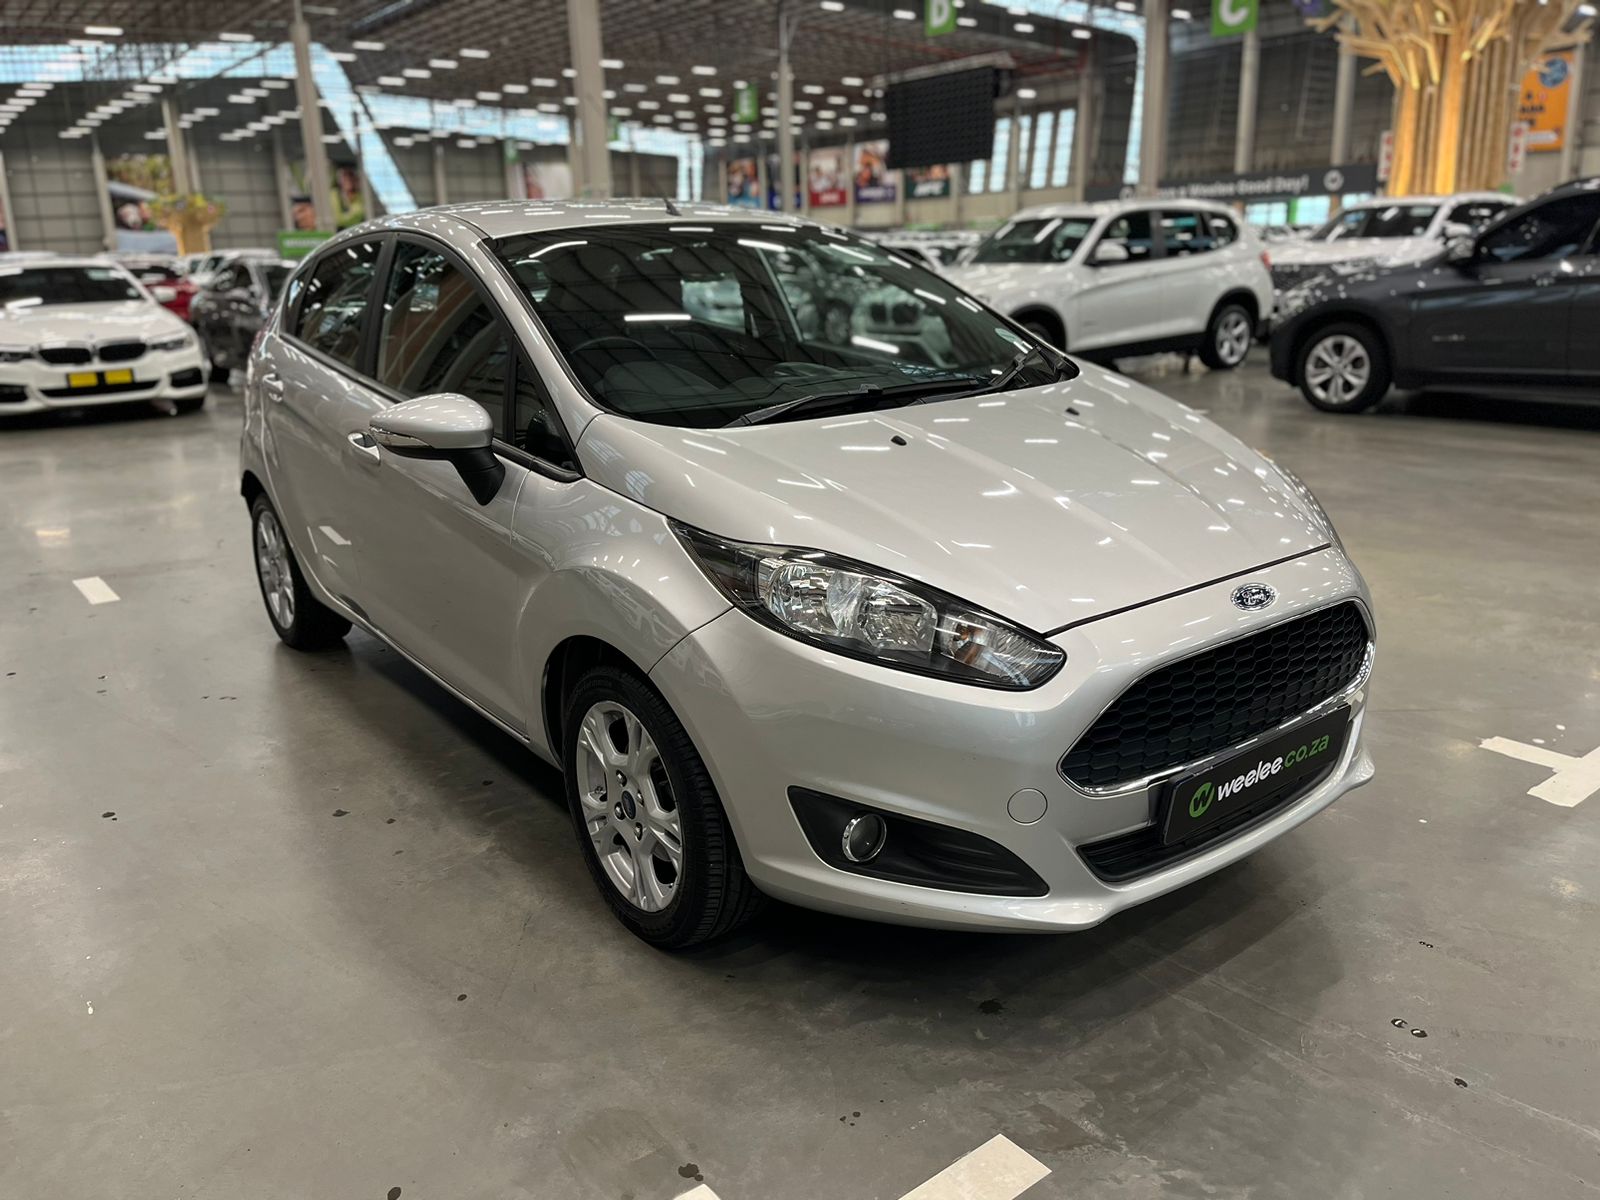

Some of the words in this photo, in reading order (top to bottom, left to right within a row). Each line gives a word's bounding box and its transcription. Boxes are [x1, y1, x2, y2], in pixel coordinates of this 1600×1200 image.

[930, 0, 950, 28] D
[1219, 0, 1249, 27] C
[1236, 178, 1272, 195] Good
